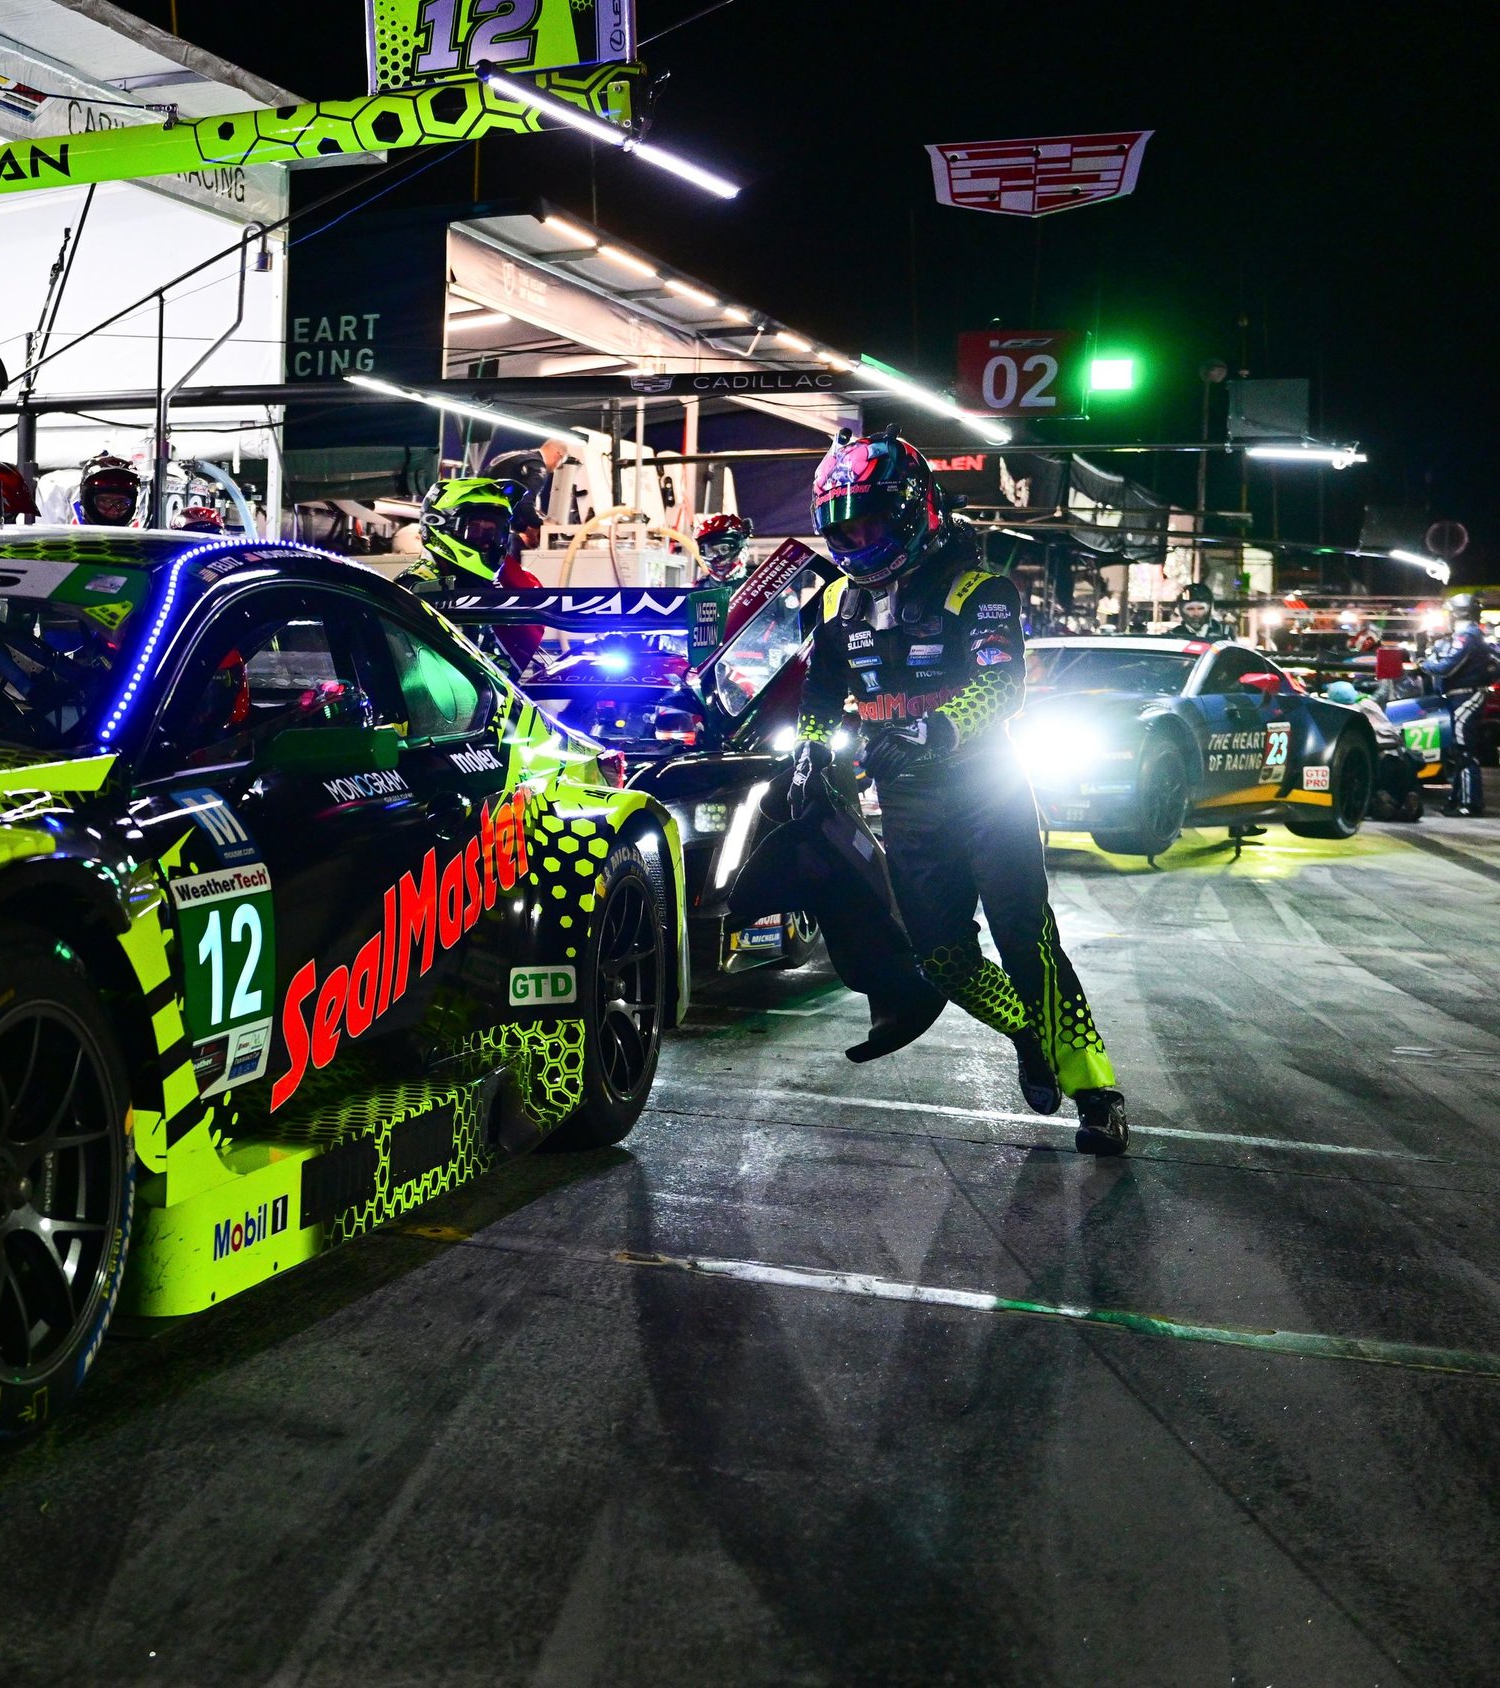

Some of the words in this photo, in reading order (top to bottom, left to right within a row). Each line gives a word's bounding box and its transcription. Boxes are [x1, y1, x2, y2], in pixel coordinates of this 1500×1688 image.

[416, 0, 533, 74] 12
[293, 312, 381, 344] EART
[288, 348, 375, 378] CING
[692, 374, 834, 390] CADILLAC
[981, 354, 1059, 409] 02
[930, 455, 984, 472] ELEN
[752, 559, 790, 598] BAMBER
[773, 564, 798, 589] LYNN
[976, 611, 1012, 620] SULLIVAN
[977, 604, 1008, 613] VASSER
[847, 639, 875, 651] SULLIVAN
[848, 630, 873, 642] VASSER
[1207, 733, 1232, 751] THE
[1231, 731, 1267, 750] HEART
[1265, 731, 1289, 766] 23
[1409, 727, 1436, 750] 27
[449, 743, 504, 774] molex
[1208, 754, 1224, 772] OF
[1224, 753, 1264, 771] RACING
[322, 769, 410, 804] MONOGRAM
[1305, 769, 1329, 778] GTD
[1305, 779, 1328, 788] PRO
[180, 794, 249, 847] M
[175, 868, 268, 902] WeatherTech
[198, 903, 263, 1026] 12
[269, 786, 532, 1114] SealMaster
[511, 972, 573, 1000] GTD
[212, 1202, 268, 1262] Mobil
